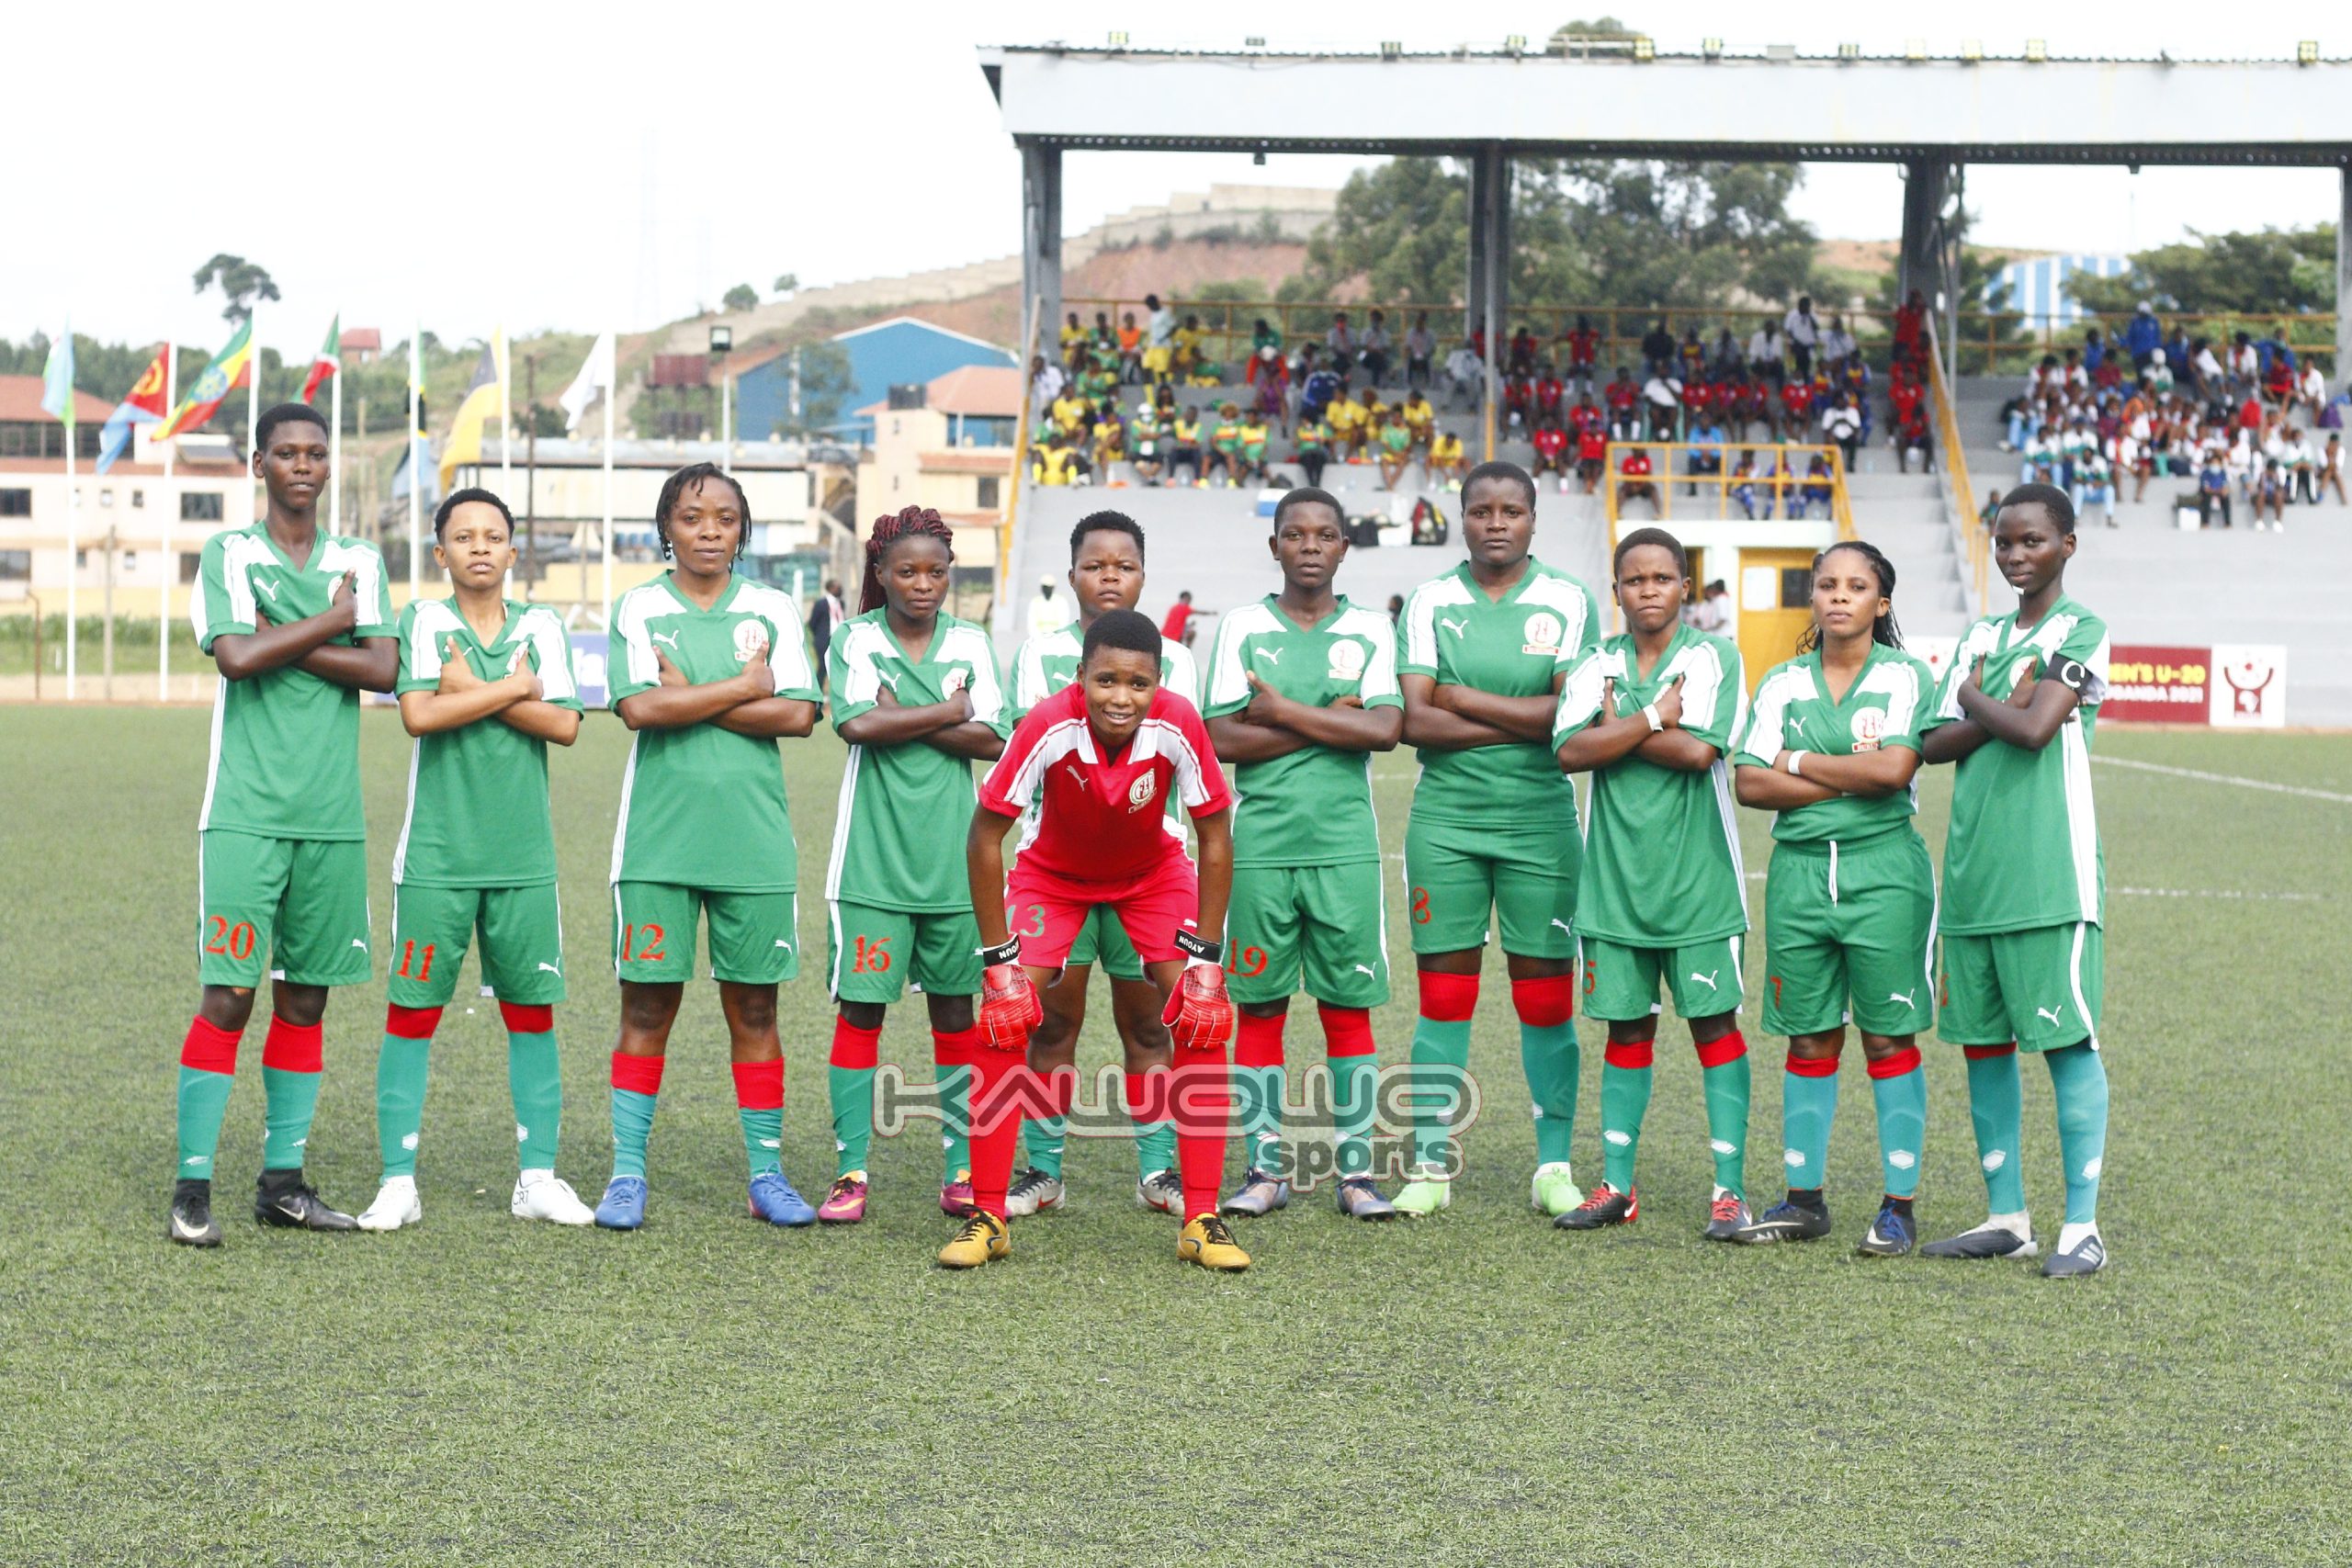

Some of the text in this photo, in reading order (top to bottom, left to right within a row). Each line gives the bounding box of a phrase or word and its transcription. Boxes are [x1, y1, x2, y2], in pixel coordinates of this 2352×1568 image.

[2061, 660, 2085, 688] C
[2155, 663, 2206, 685] U-20
[1412, 886, 1431, 924] 8
[206, 915, 255, 960] 20
[622, 923, 665, 962] 12
[852, 934, 891, 974] 16
[1227, 937, 1268, 977] 19
[397, 938, 435, 982] 11
[513, 1190, 528, 1205] CR7
